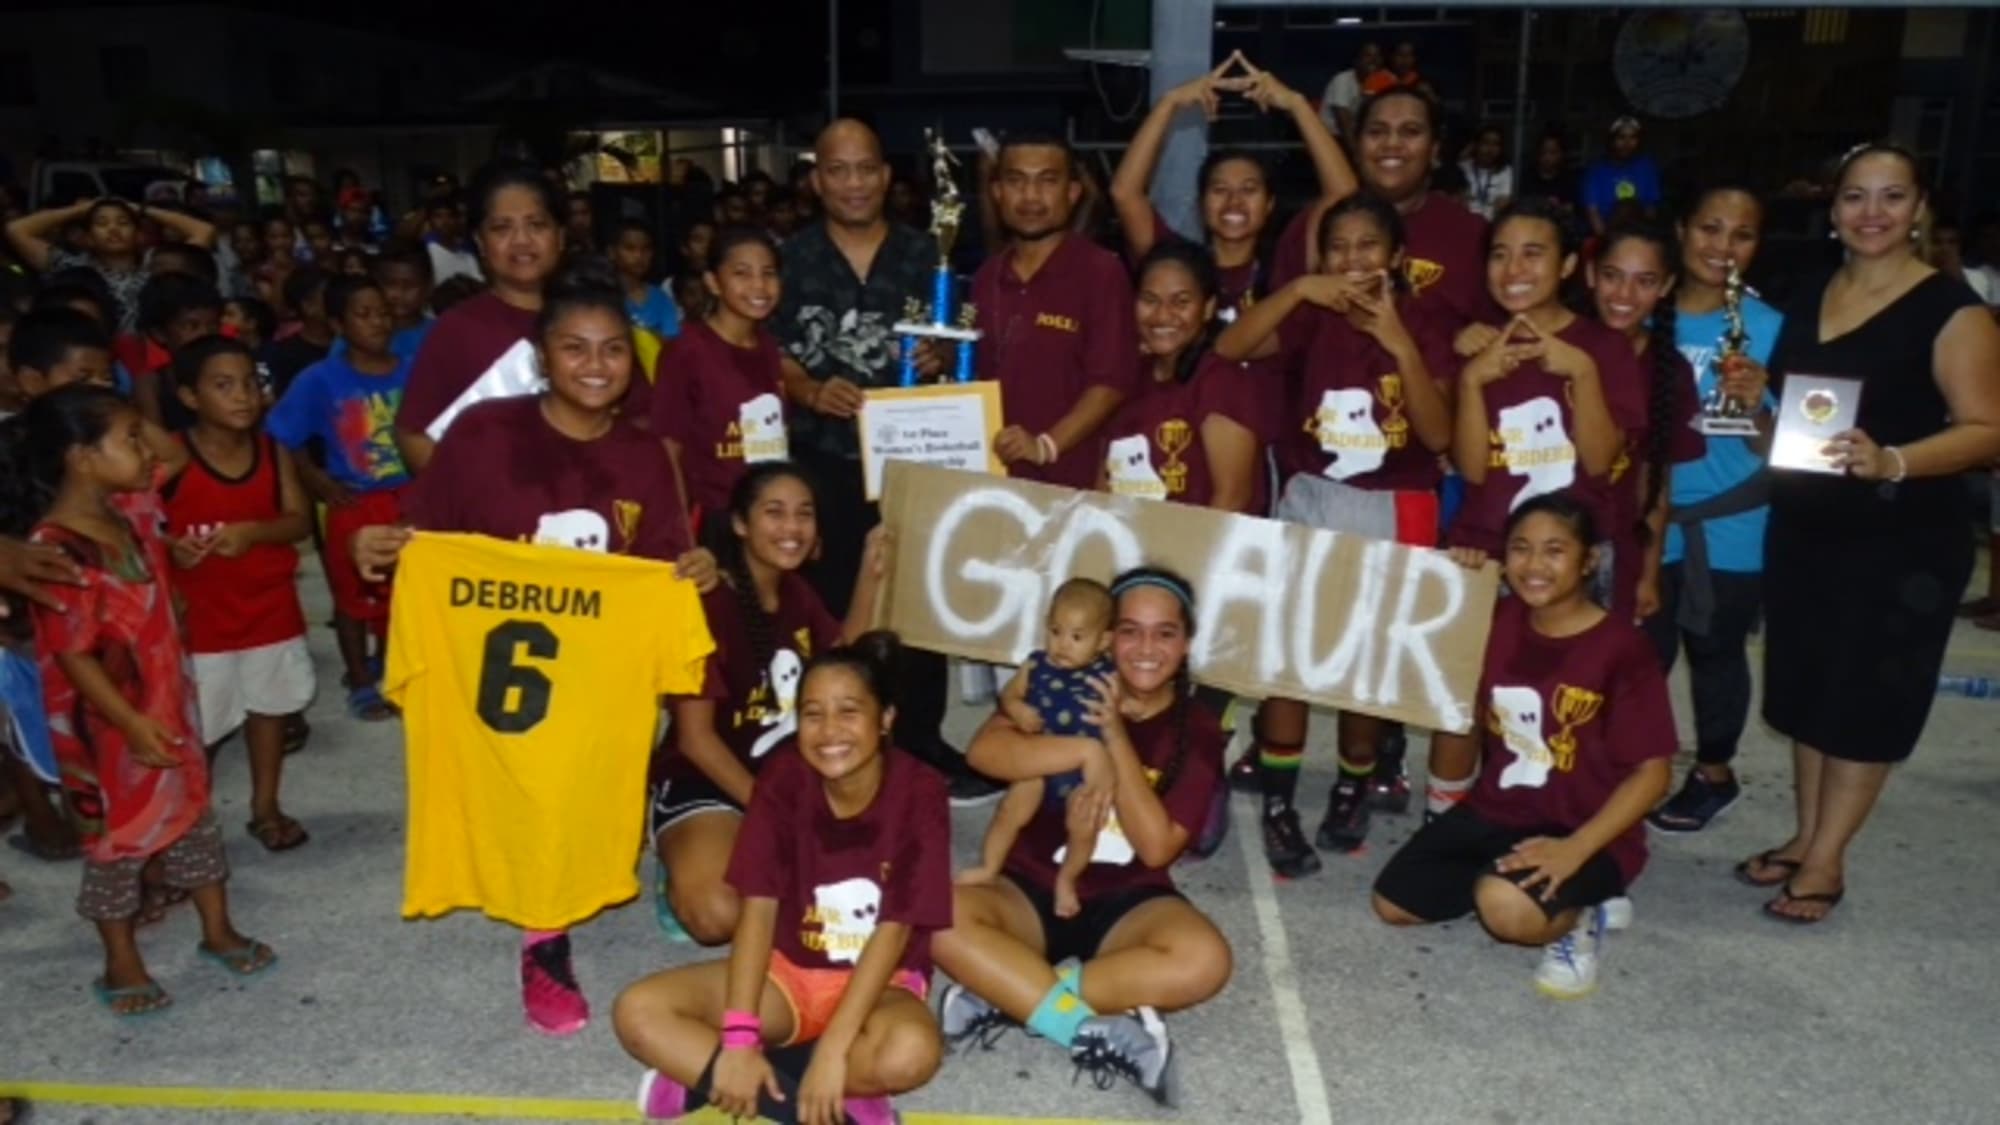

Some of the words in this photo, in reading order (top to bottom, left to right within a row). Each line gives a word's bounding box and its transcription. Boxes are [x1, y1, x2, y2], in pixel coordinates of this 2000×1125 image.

[920, 427, 949, 439] Place
[450, 576, 601, 619] DEBRUM
[926, 487, 1146, 666] GO
[1192, 513, 1474, 734] AUR
[477, 619, 559, 734] 6
